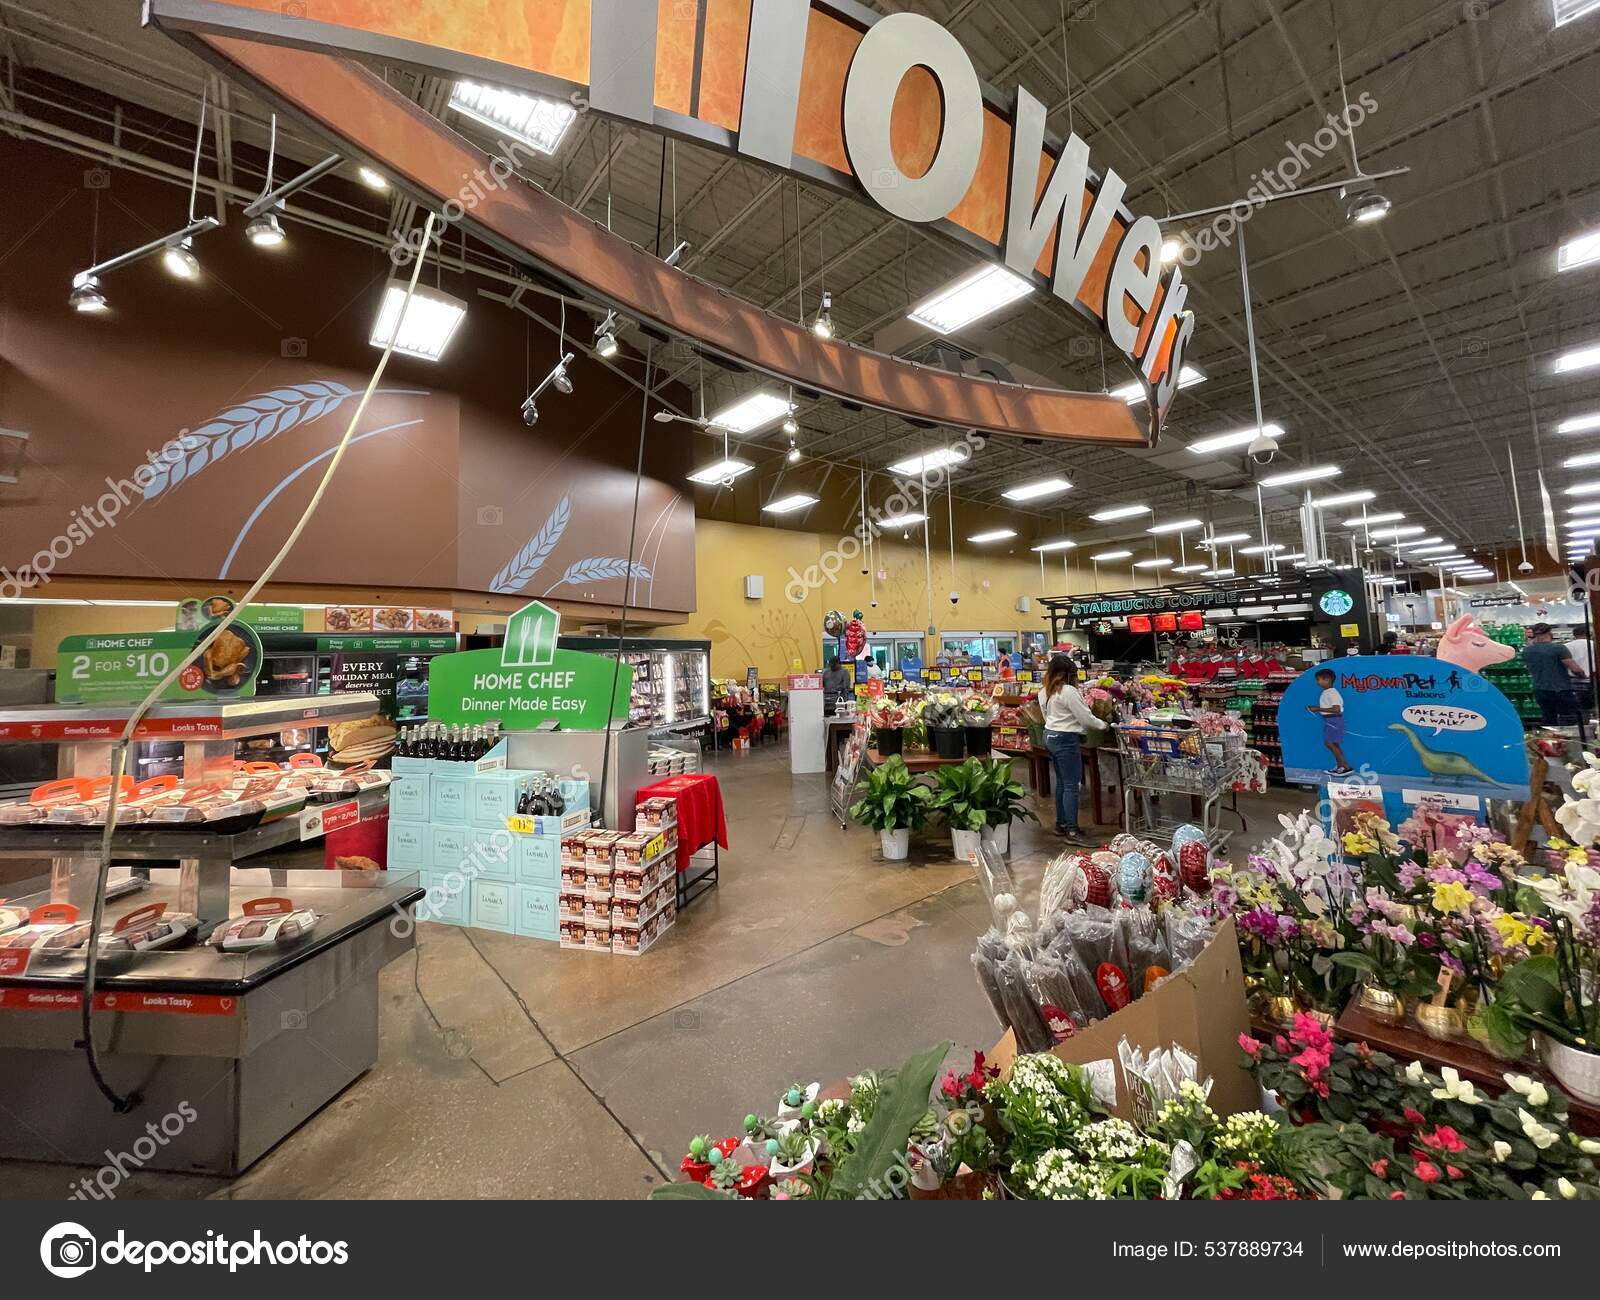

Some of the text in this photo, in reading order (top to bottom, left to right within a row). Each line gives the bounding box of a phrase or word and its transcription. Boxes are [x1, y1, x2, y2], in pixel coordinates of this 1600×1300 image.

[1072, 591, 1238, 615] STARBUCKS COFFEE
[97, 638, 154, 649] HOME CHEF
[72, 652, 169, 679] 2 FOR $10
[342, 662, 384, 672] EVERY
[372, 672, 395, 680] MEAL
[474, 671, 576, 690] HOME CHEF
[345, 681, 374, 689] deserves
[1341, 672, 1437, 693] MyOwnPet
[1405, 690, 1445, 699] Balloons
[462, 696, 587, 714] Dinner Made Easy
[1408, 708, 1434, 716] TAKE
[1458, 712, 1478, 720] FOR
[172, 722, 220, 733] Looks Tasty.
[1430, 718, 1465, 726] WALK!
[64, 726, 89, 735] Smells
[143, 996, 194, 1008] Looks Tasty.
